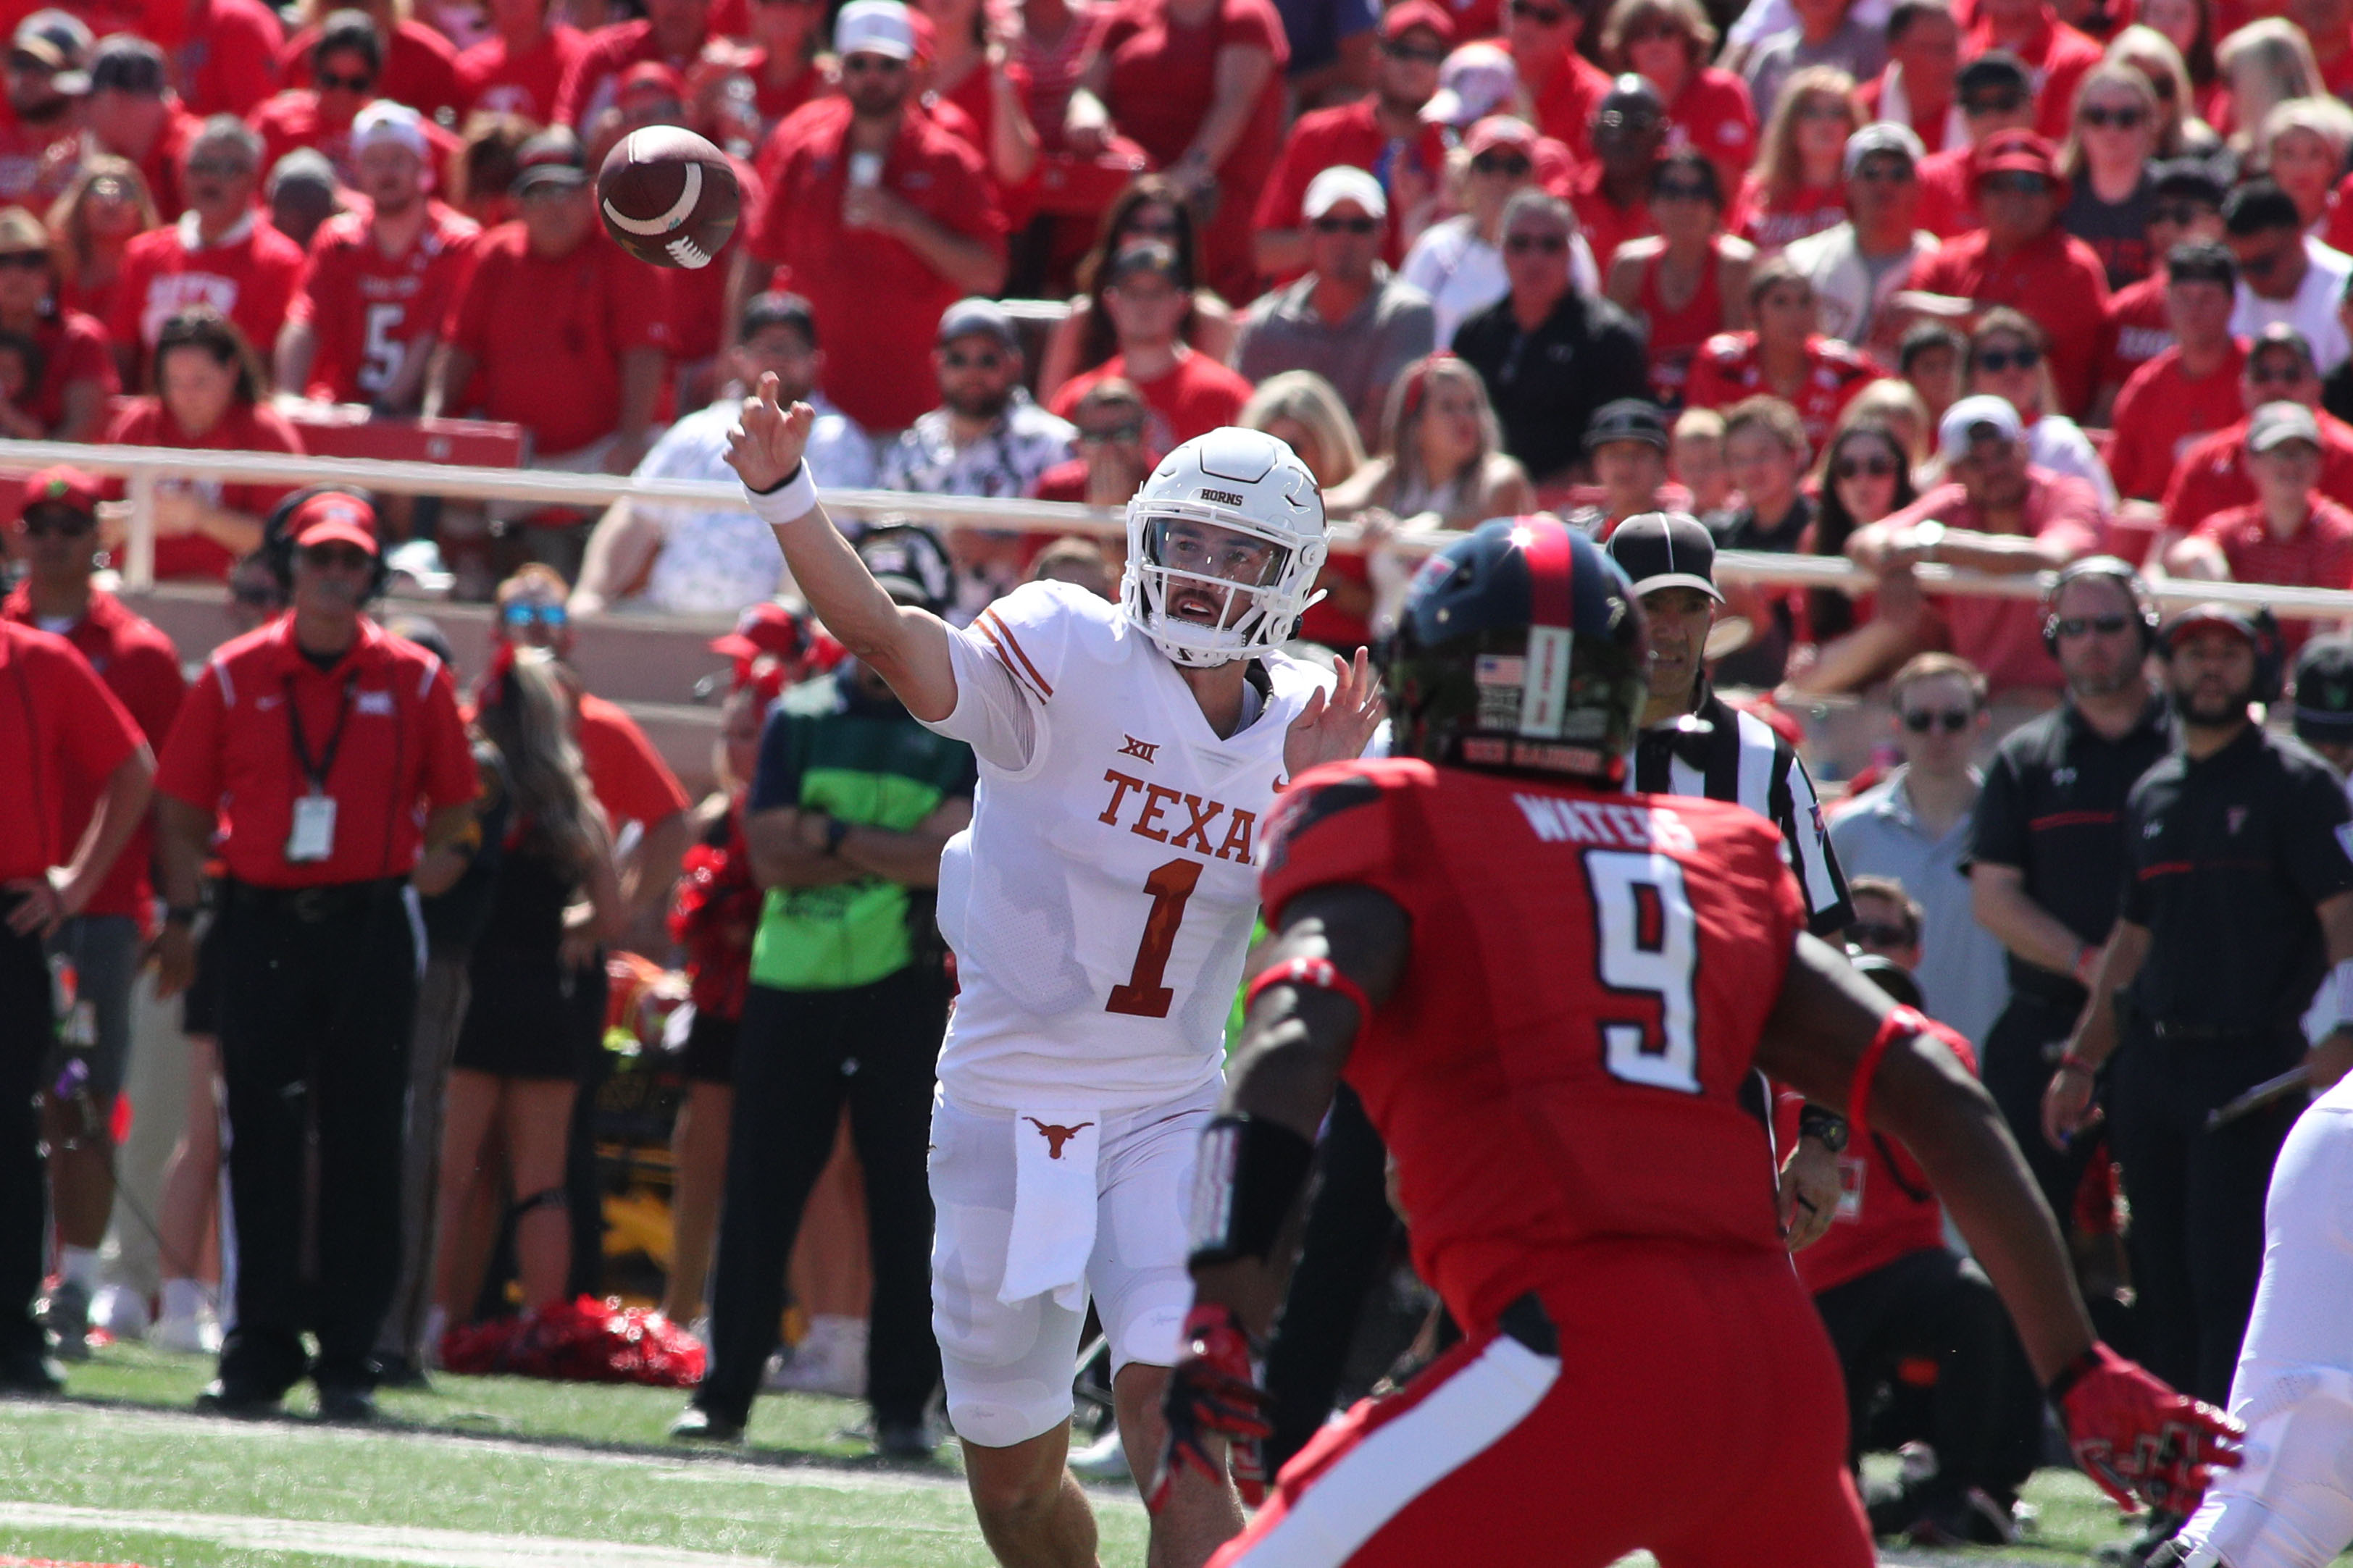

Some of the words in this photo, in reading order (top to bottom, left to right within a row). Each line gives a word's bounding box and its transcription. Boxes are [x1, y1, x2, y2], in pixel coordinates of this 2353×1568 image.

[358, 303, 405, 391] 5
[1200, 488, 1244, 506] HORNS
[1117, 733, 1161, 765] XII
[1098, 768, 1261, 866] TEXA
[1513, 793, 1697, 851] WATERS
[1105, 858, 1204, 1018] 1
[1581, 848, 1702, 1094] 9
